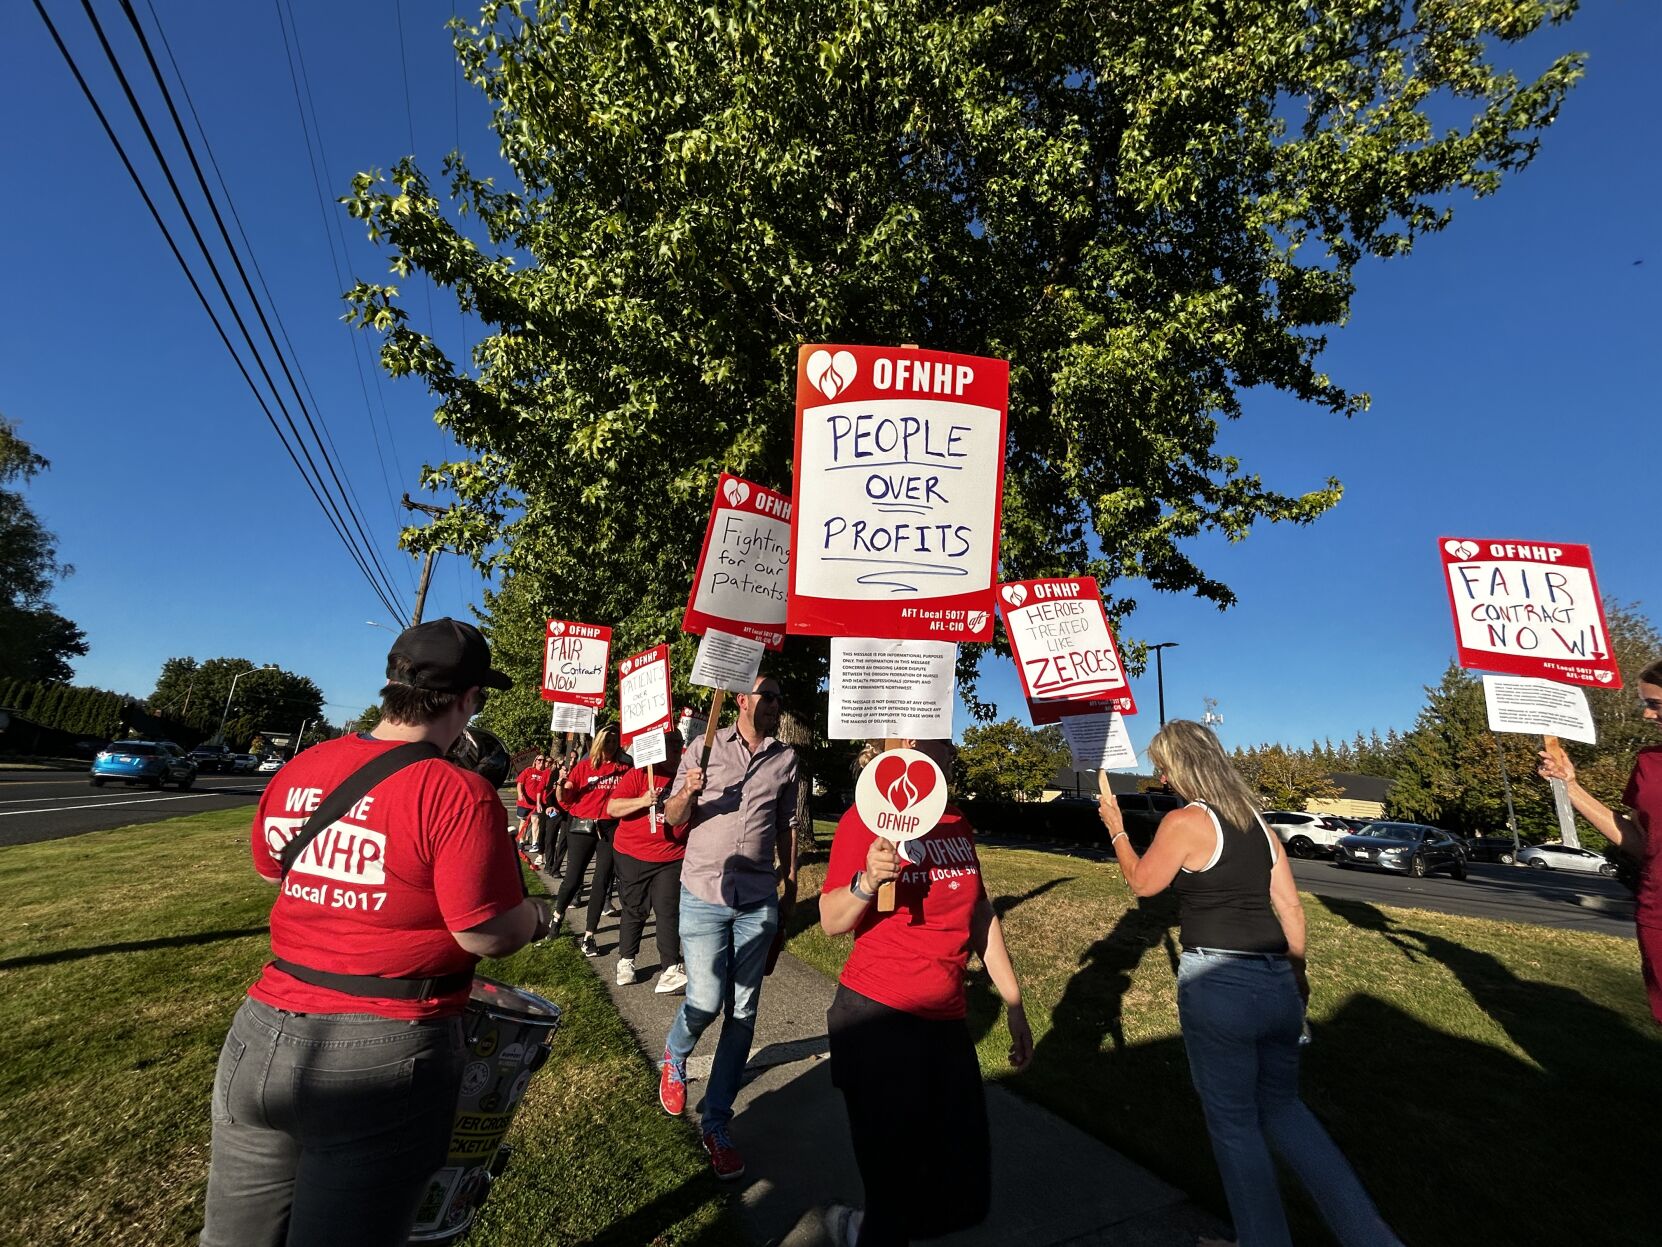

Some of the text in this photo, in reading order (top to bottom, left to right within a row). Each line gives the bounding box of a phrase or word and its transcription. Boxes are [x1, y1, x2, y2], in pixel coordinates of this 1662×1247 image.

[873, 358, 974, 395] OFNHP
[827, 415, 971, 462] PEOPLE
[866, 474, 949, 503] OVER
[723, 517, 790, 564] Fighting
[824, 517, 971, 557] PROFITS
[719, 550, 783, 577] for our
[1490, 544, 1563, 562] OFNHP
[1033, 582, 1080, 598] OFNHP
[1458, 566, 1574, 606] FAIR
[901, 608, 965, 620] AFT Local 5017
[1026, 602, 1085, 624] HEROES
[1471, 603, 1575, 623] CONTRACT
[569, 625, 600, 638] OFNHP
[930, 621, 964, 631] AFL-CIO
[1026, 618, 1089, 640] TREATED
[550, 637, 583, 661] FAIR
[1047, 637, 1075, 652] LIKE
[1487, 624, 1606, 660] NOW!
[634, 651, 658, 668] OFNHP
[1026, 649, 1116, 689] ZEROES
[547, 672, 577, 691] NOW
[623, 665, 665, 695] PATIENTS
[623, 693, 666, 722] PROFITS
[285, 787, 323, 812] WE
[877, 812, 920, 833] OFNHP
[926, 837, 974, 865] OFNHP
[902, 865, 978, 883] AFT LOCAL 50
[284, 876, 387, 911] Local 5017
